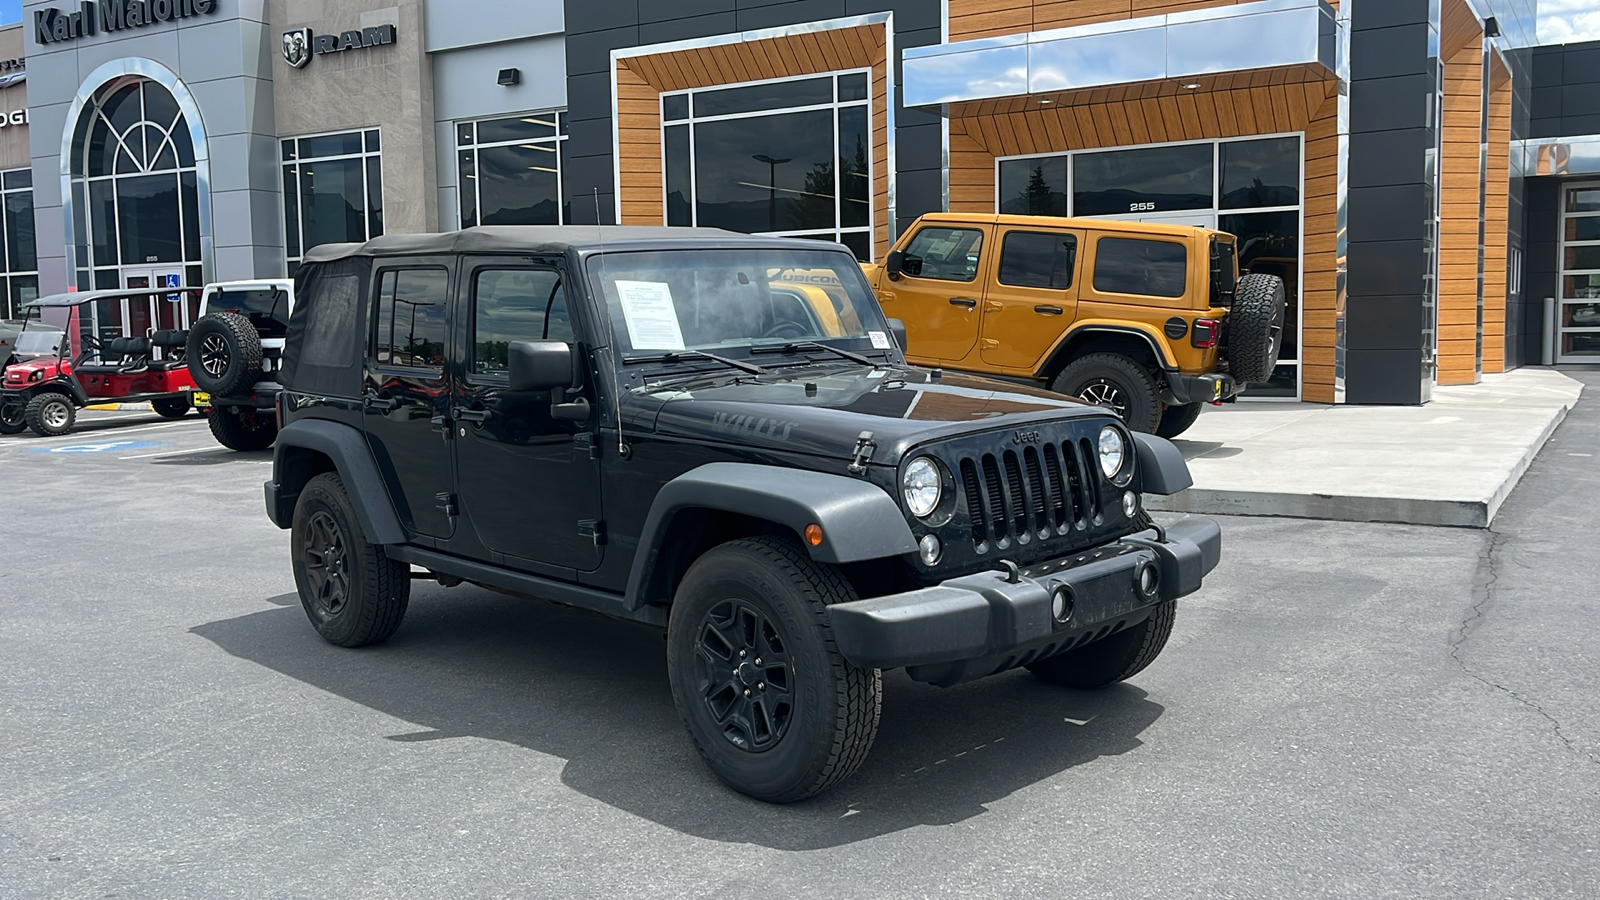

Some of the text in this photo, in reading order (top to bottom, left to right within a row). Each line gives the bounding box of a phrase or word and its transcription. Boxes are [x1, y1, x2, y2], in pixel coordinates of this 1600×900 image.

[34, 0, 217, 44] Karl Malone
[314, 24, 397, 55] RAM
[1130, 202, 1156, 212] 255
[711, 411, 799, 441] WILLYS
[1012, 430, 1040, 445] Jeep
